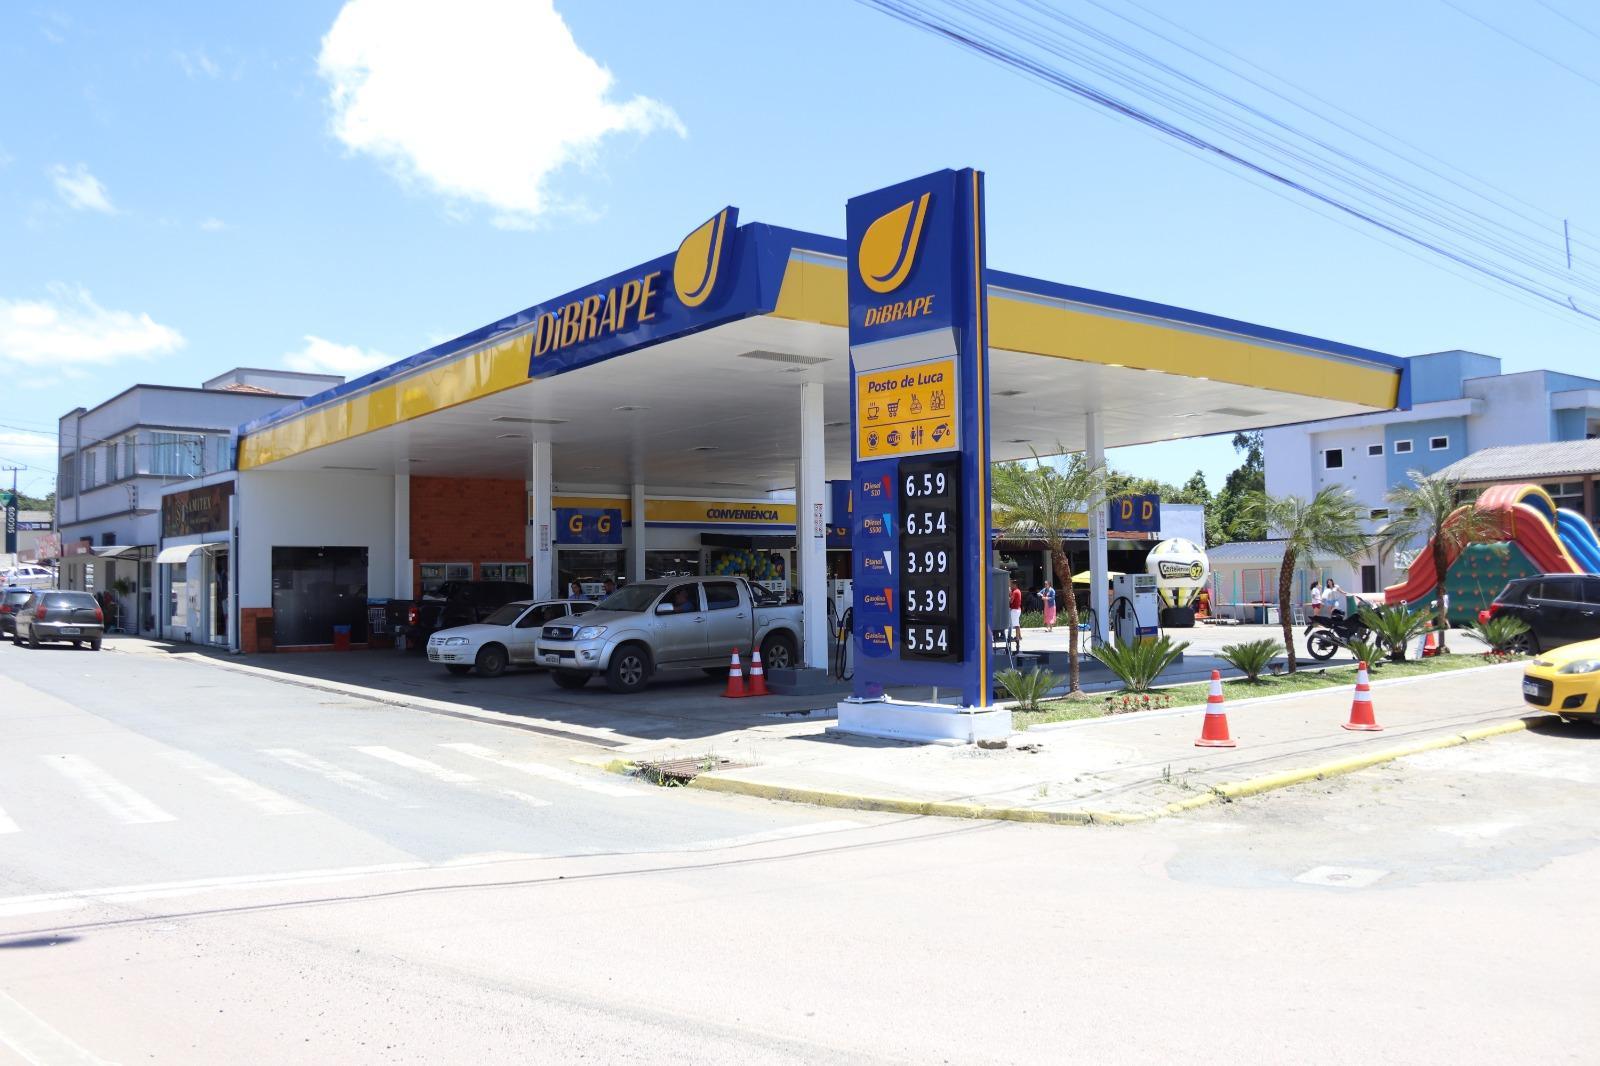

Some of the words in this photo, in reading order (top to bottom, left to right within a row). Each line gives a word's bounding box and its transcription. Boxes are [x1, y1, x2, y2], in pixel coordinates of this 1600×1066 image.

[534, 271, 661, 357] DiBRAPE
[864, 295, 935, 327] DiBRAPE
[868, 380, 898, 393] Posto
[900, 375, 915, 388] de
[917, 372, 944, 385] Luca
[864, 482, 881, 491] Diesel
[870, 489, 881, 497] S10
[906, 472, 945, 497] 6,59
[707, 505, 778, 520] CONVENIÊNCIA
[1121, 500, 1133, 520] D
[1142, 501, 1153, 520] D
[569, 514, 583, 532] G
[597, 515, 611, 533] G
[864, 518, 882, 528] Diesel
[907, 511, 947, 535] 6,54
[864, 557, 883, 567] Etanol
[907, 551, 947, 573] 3,99
[864, 594, 886, 603] Gasolina
[907, 590, 947, 612] 5,39
[864, 632, 886, 640] Gasolina
[907, 628, 948, 651] 5,54
